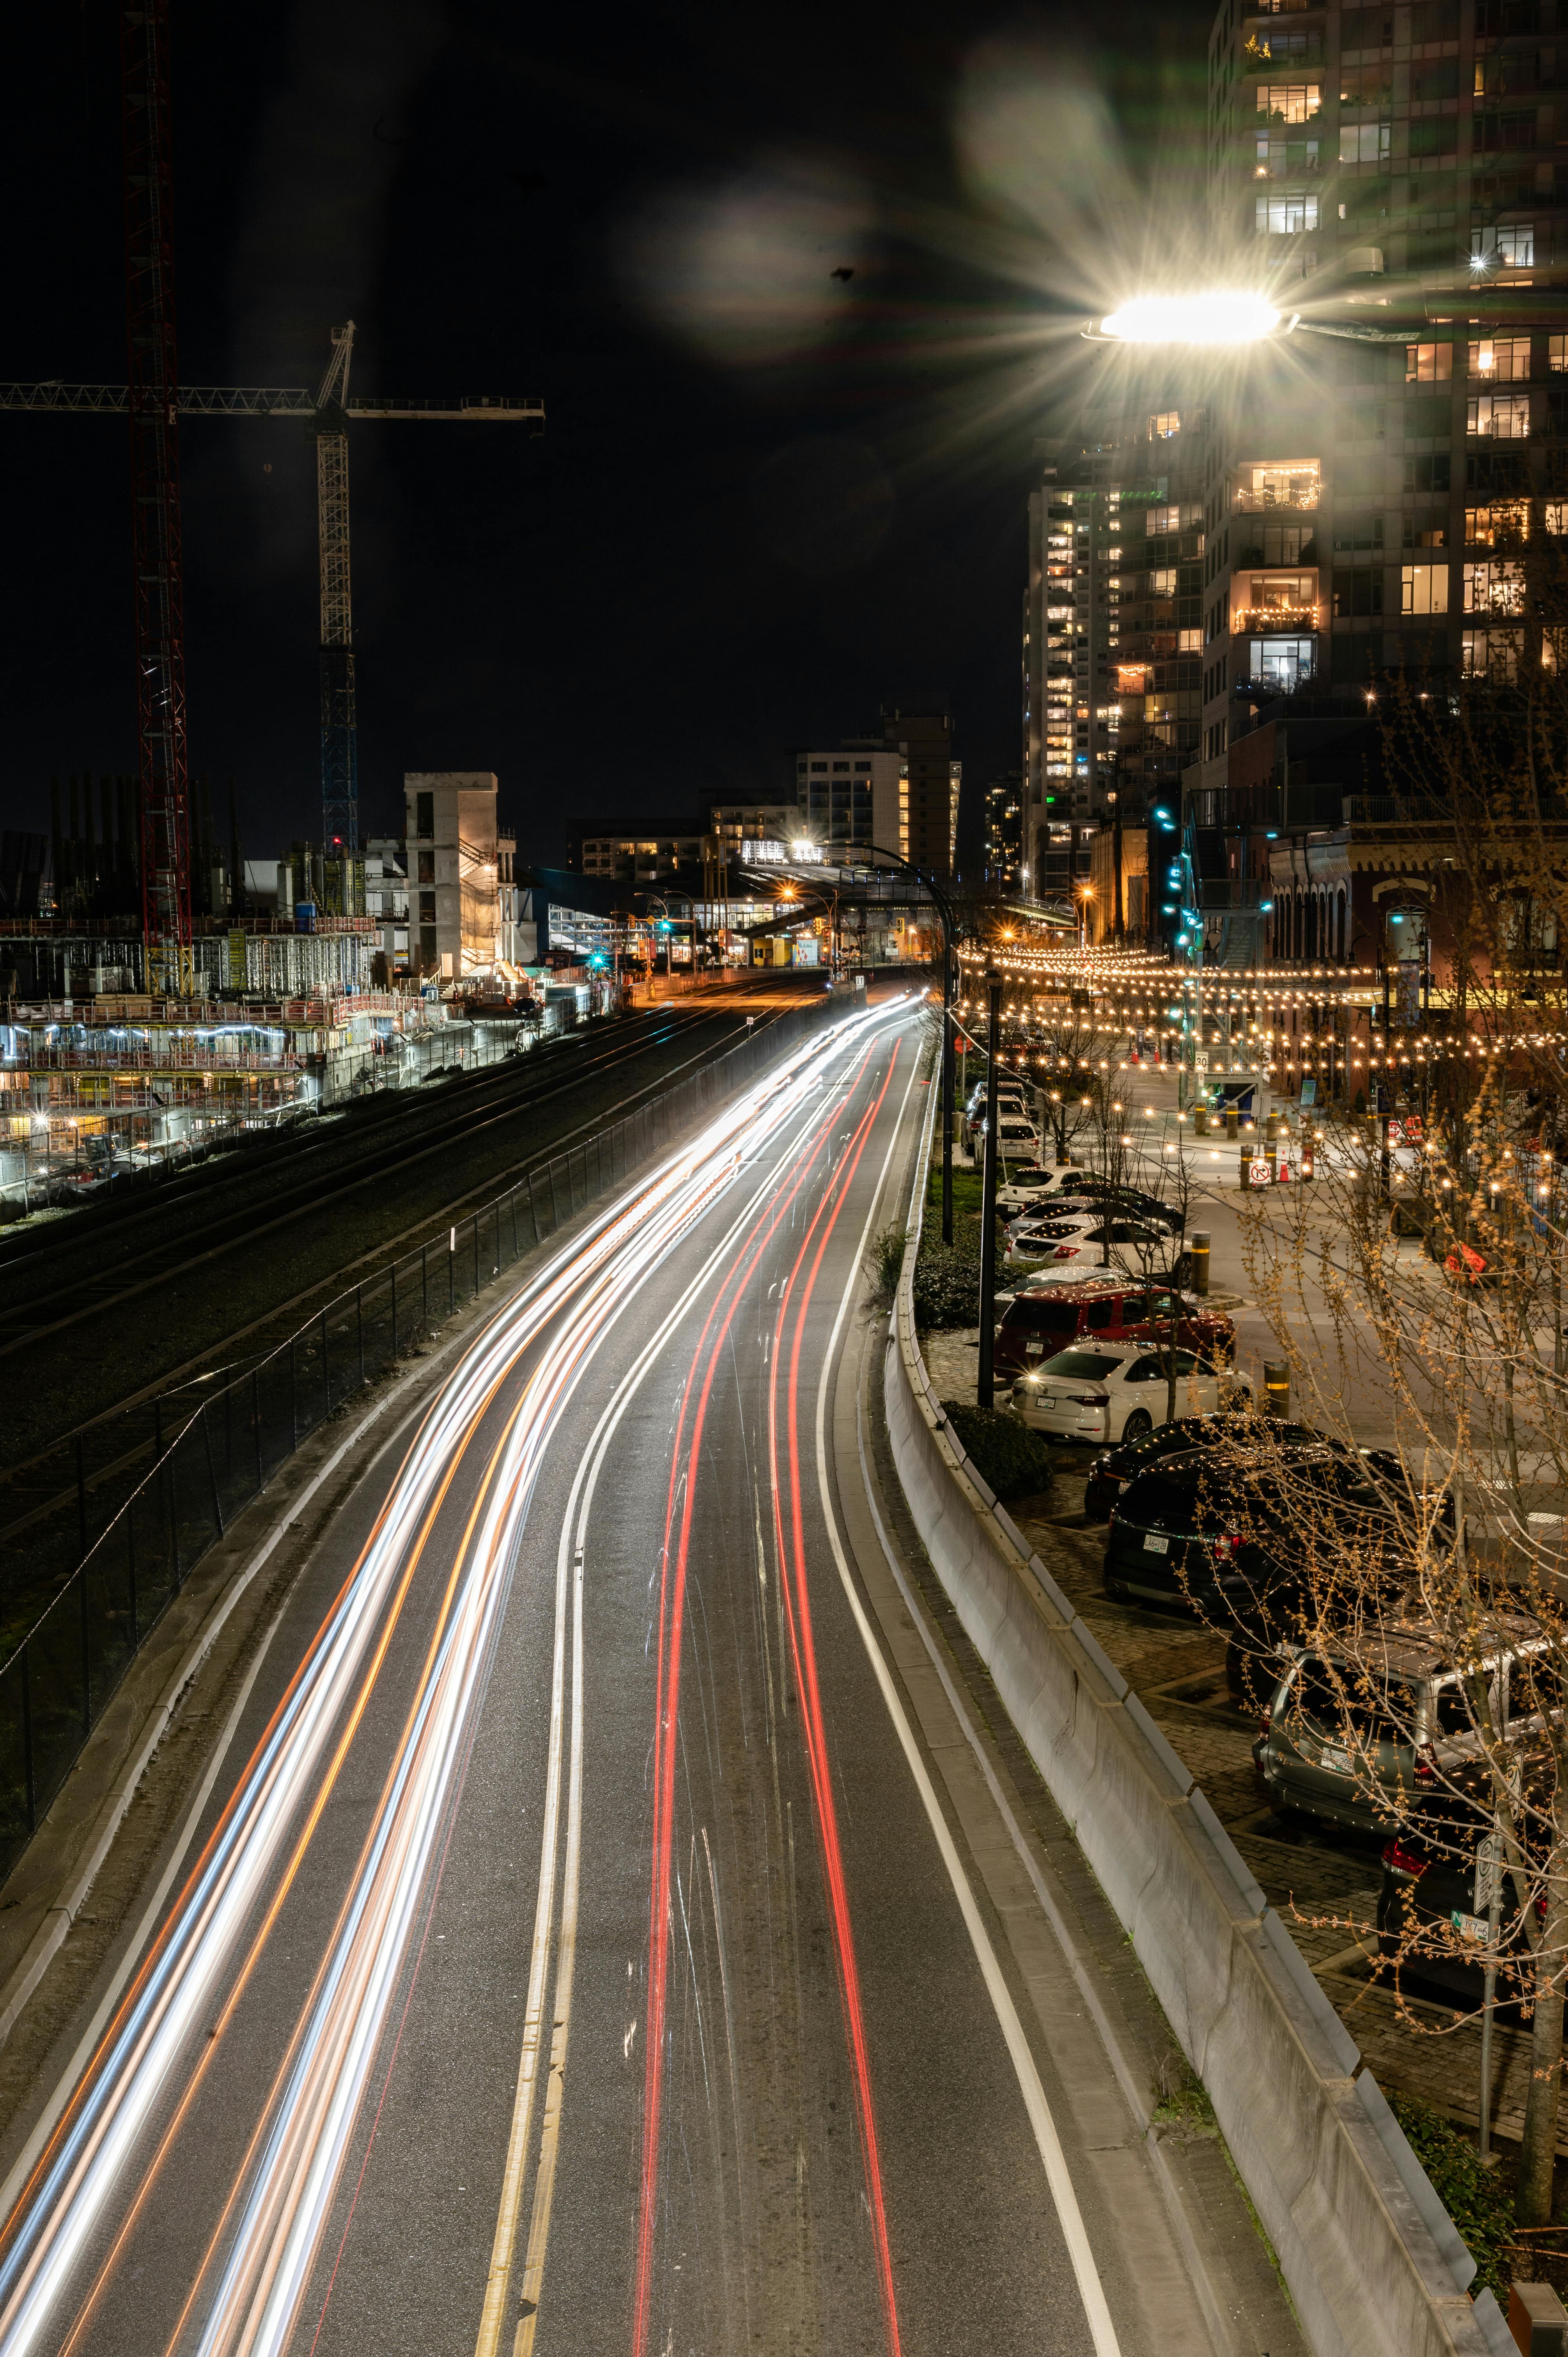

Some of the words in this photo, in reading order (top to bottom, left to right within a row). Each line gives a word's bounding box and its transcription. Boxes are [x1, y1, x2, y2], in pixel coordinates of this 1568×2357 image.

[745, 840, 779, 858] RIVER
[1197, 1057, 1207, 1068] 30
[1453, 1911, 1462, 1923] N
